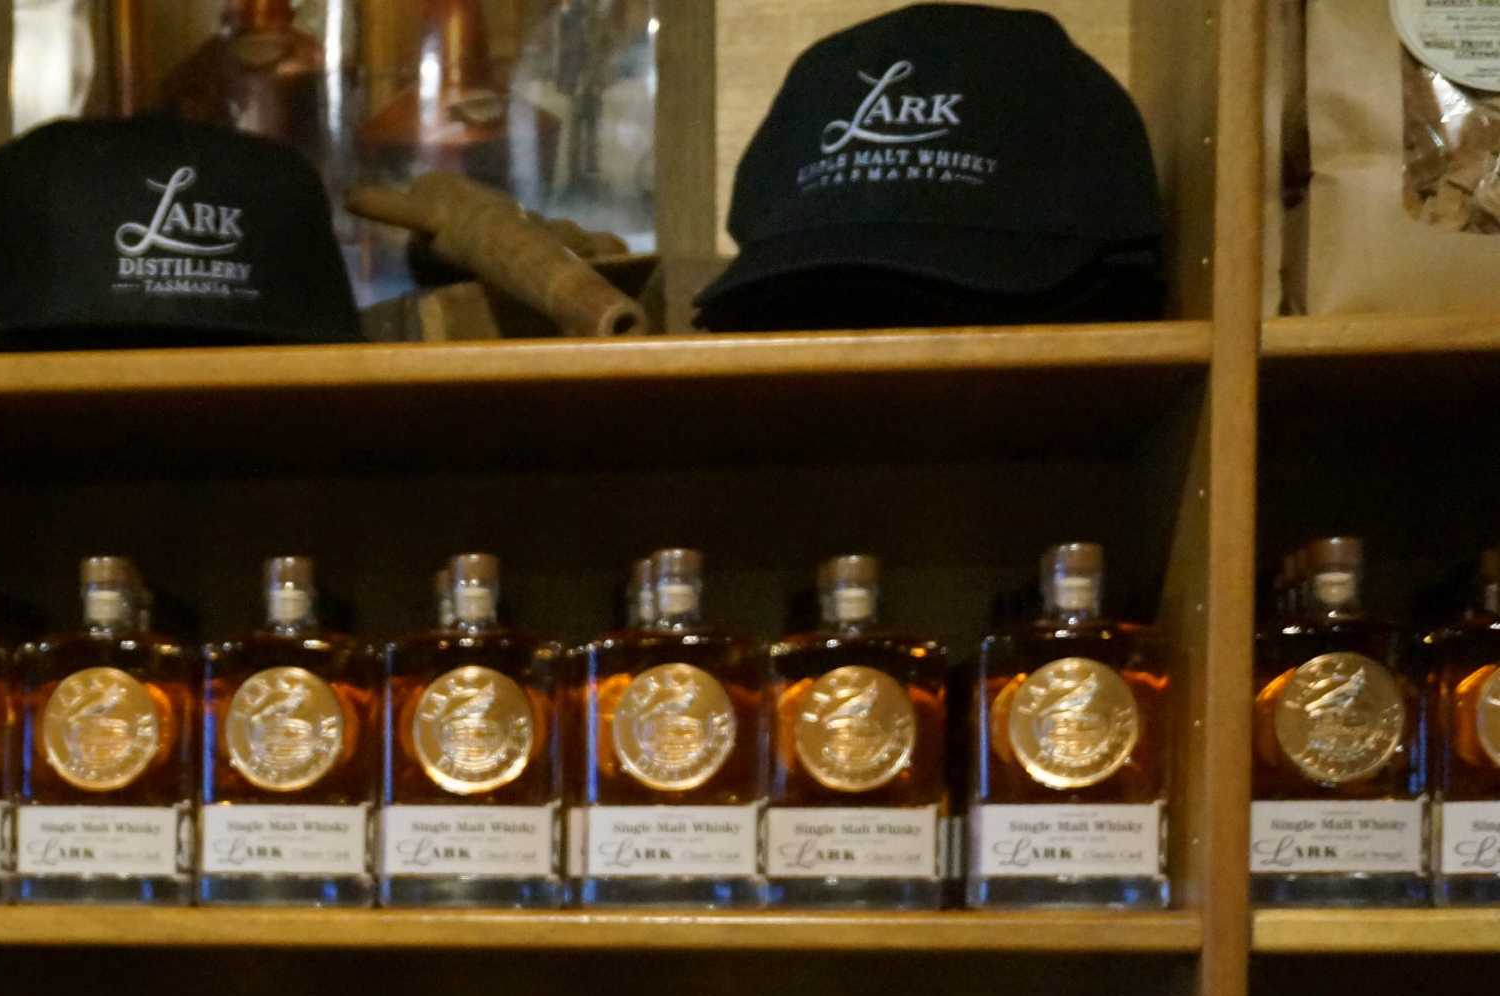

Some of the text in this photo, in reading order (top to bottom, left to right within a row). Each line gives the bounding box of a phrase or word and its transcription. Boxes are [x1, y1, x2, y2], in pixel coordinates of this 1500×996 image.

[821, 60, 963, 154] LARK
[854, 148, 910, 165] MALT
[916, 150, 998, 174] WHISKY
[115, 166, 243, 255] LARK
[117, 257, 251, 281] DISTILLERY
[144, 280, 231, 296] TASMANIA
[26, 836, 95, 866] LARK
[213, 836, 283, 866] LARK
[396, 836, 471, 866] LARK
[598, 837, 673, 868] LARK
[778, 838, 855, 869] LARK
[992, 837, 1073, 867] LARK
[1253, 834, 1338, 867] LARK
